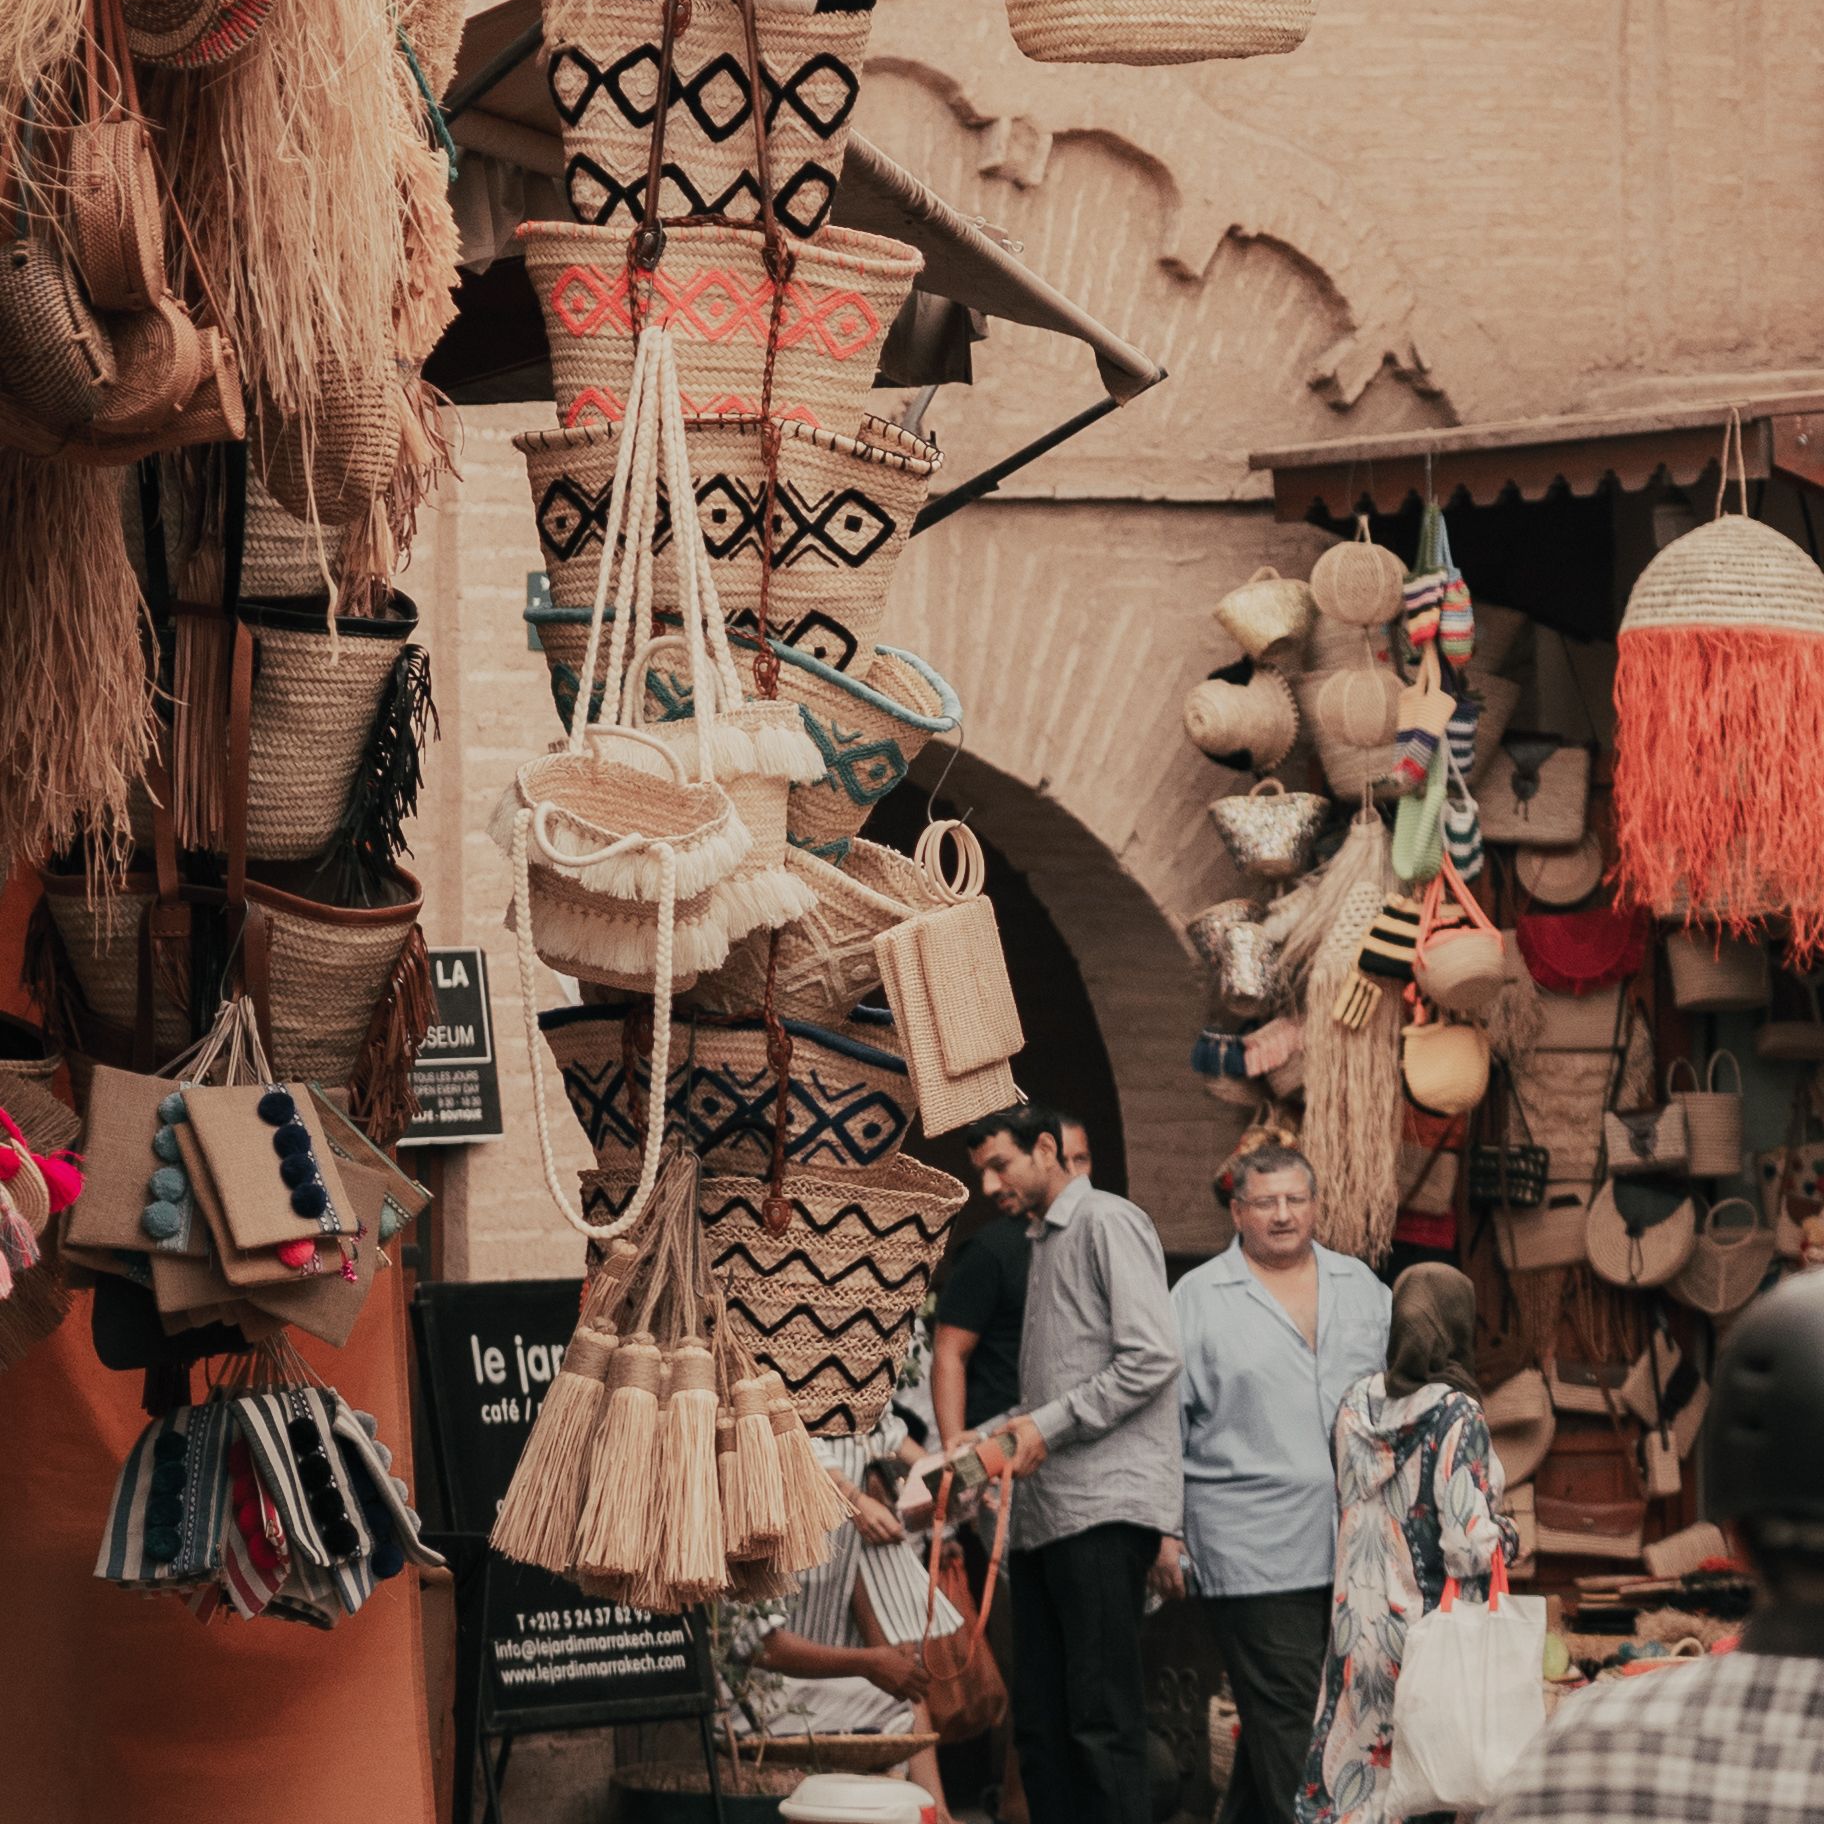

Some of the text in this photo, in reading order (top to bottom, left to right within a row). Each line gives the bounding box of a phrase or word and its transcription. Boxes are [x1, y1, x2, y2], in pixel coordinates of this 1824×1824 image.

[436, 959, 470, 988] LA
[436, 1070, 451, 1083] LES
[471, 1334, 507, 1385] le
[481, 1397, 520, 1424] café
[517, 1613, 526, 1632] T
[529, 1610, 560, 1632] +212
[563, 1609, 572, 1629] 5
[575, 1608, 593, 1628] 24
[595, 1606, 611, 1625] 37
[494, 1629, 685, 1661] info@lejardinmarrakech.com
[501, 1653, 686, 1685] www.lejardinmarrakech.com
